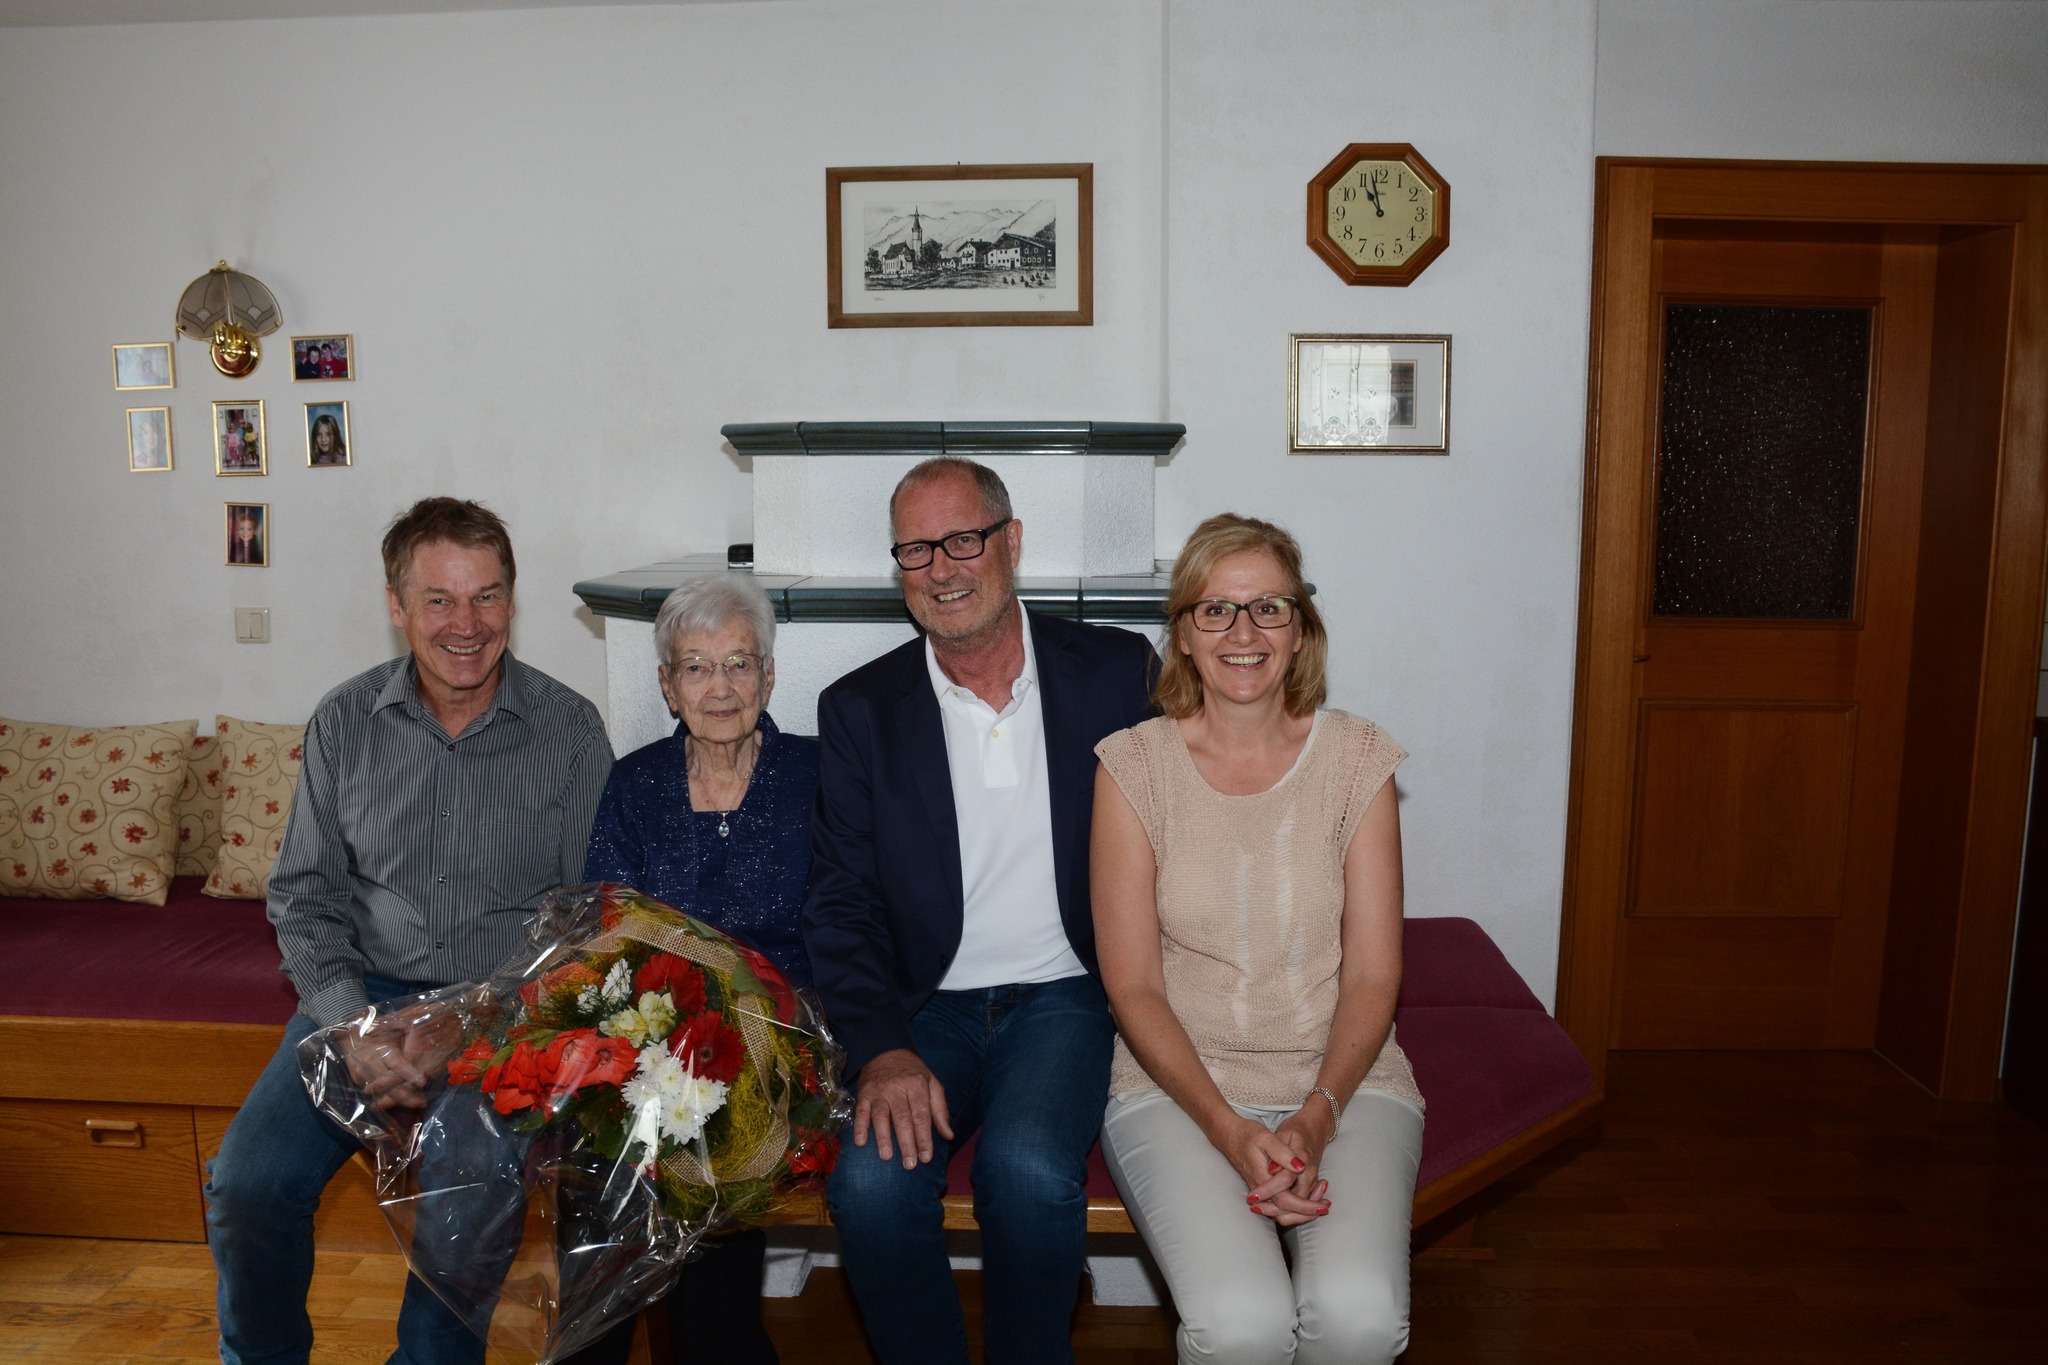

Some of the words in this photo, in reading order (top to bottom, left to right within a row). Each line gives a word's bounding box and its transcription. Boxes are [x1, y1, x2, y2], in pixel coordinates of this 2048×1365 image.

[1360, 173, 1367, 188] 11
[1374, 169, 1389, 184] 12
[1397, 173, 1402, 188] 1
[1343, 187, 1356, 202] 10
[1409, 187, 1419, 202] 2
[1336, 206, 1346, 221] 9
[1415, 207, 1425, 222] 3
[1343, 225, 1353, 240] 8
[1406, 226, 1416, 241] 4
[1358, 238, 1368, 254] 7
[1374, 243, 1384, 258] 6
[1393, 239, 1403, 254] 5
